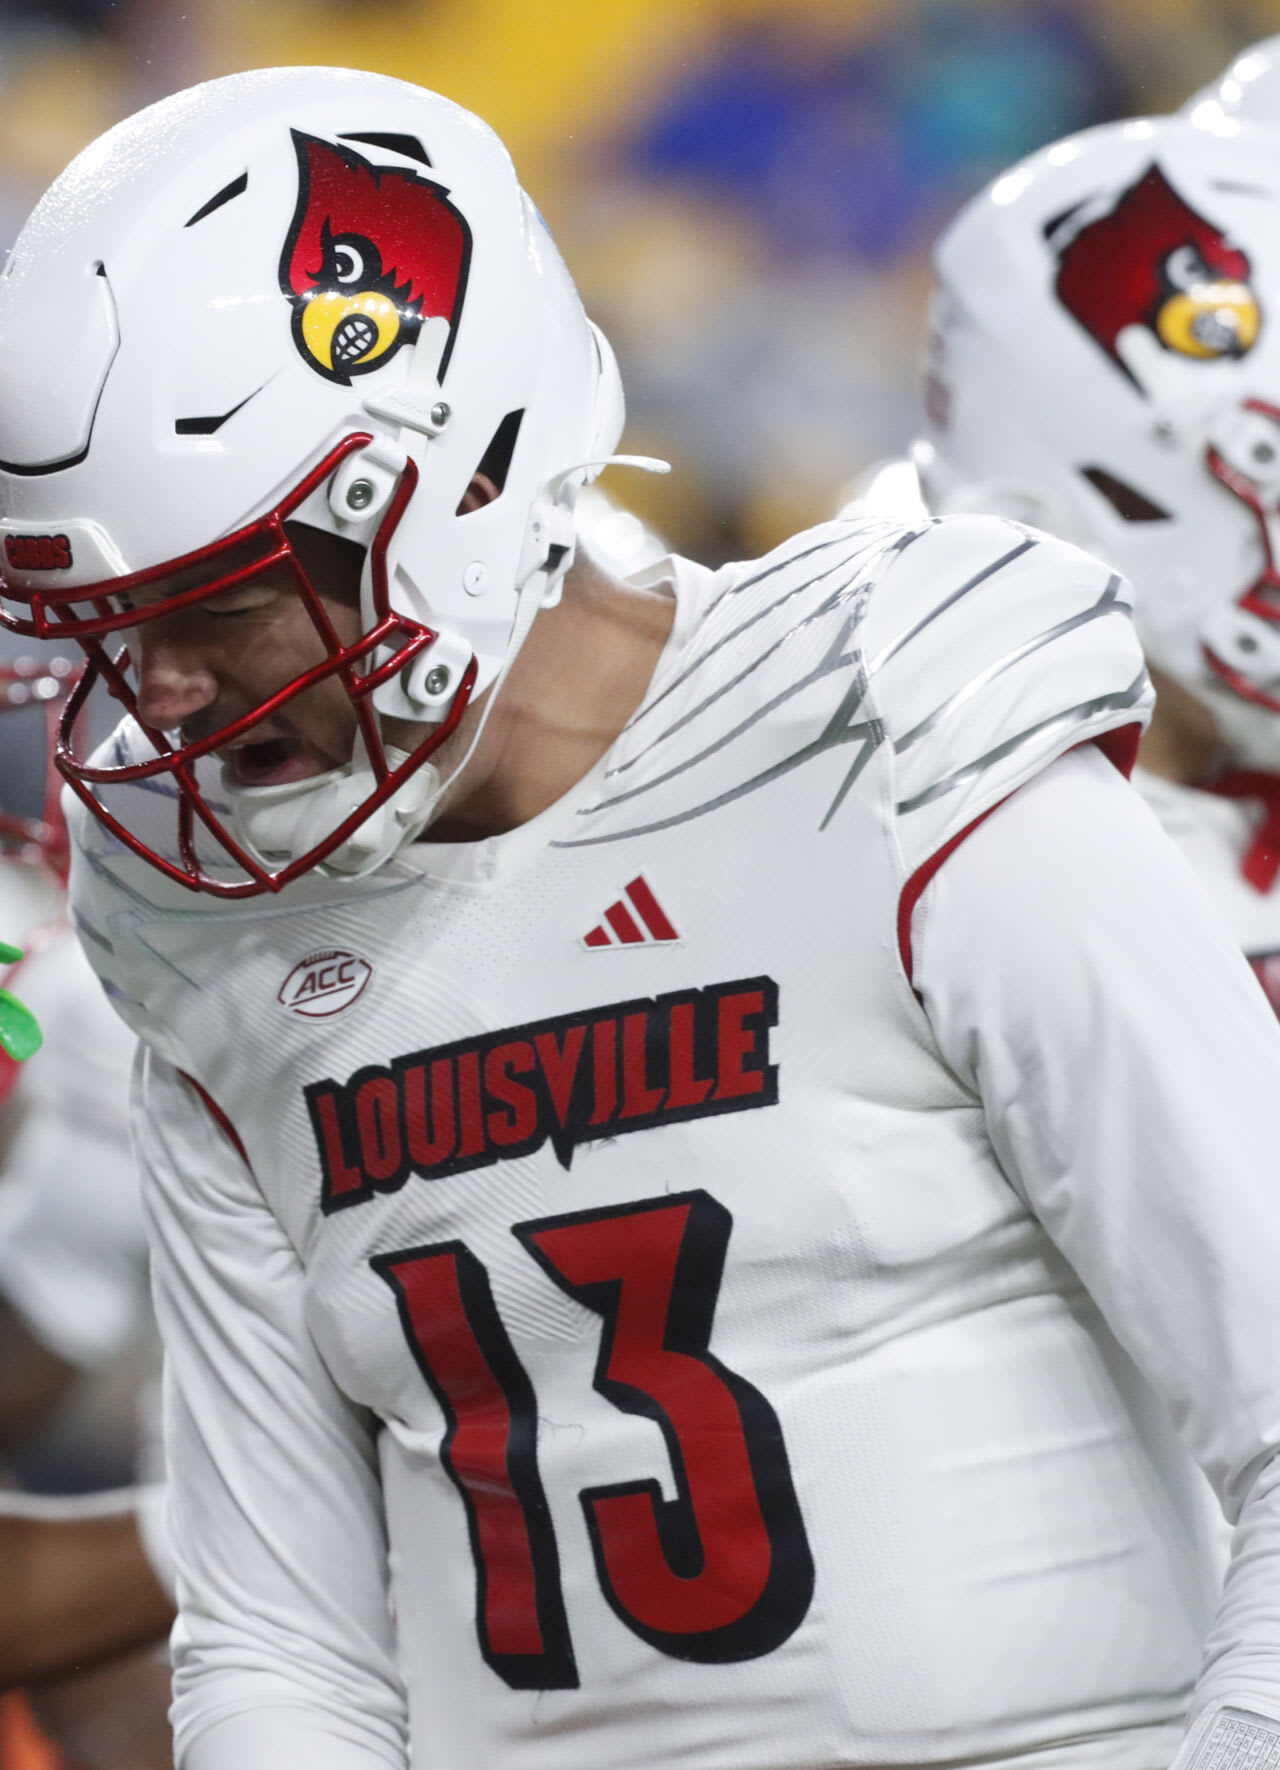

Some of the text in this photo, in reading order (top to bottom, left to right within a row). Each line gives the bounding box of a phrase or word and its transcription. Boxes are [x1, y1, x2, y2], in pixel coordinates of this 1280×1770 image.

[293, 959, 355, 999] ACC
[302, 975, 779, 1216] LOUISVILLE
[369, 1188, 815, 1690] 13
